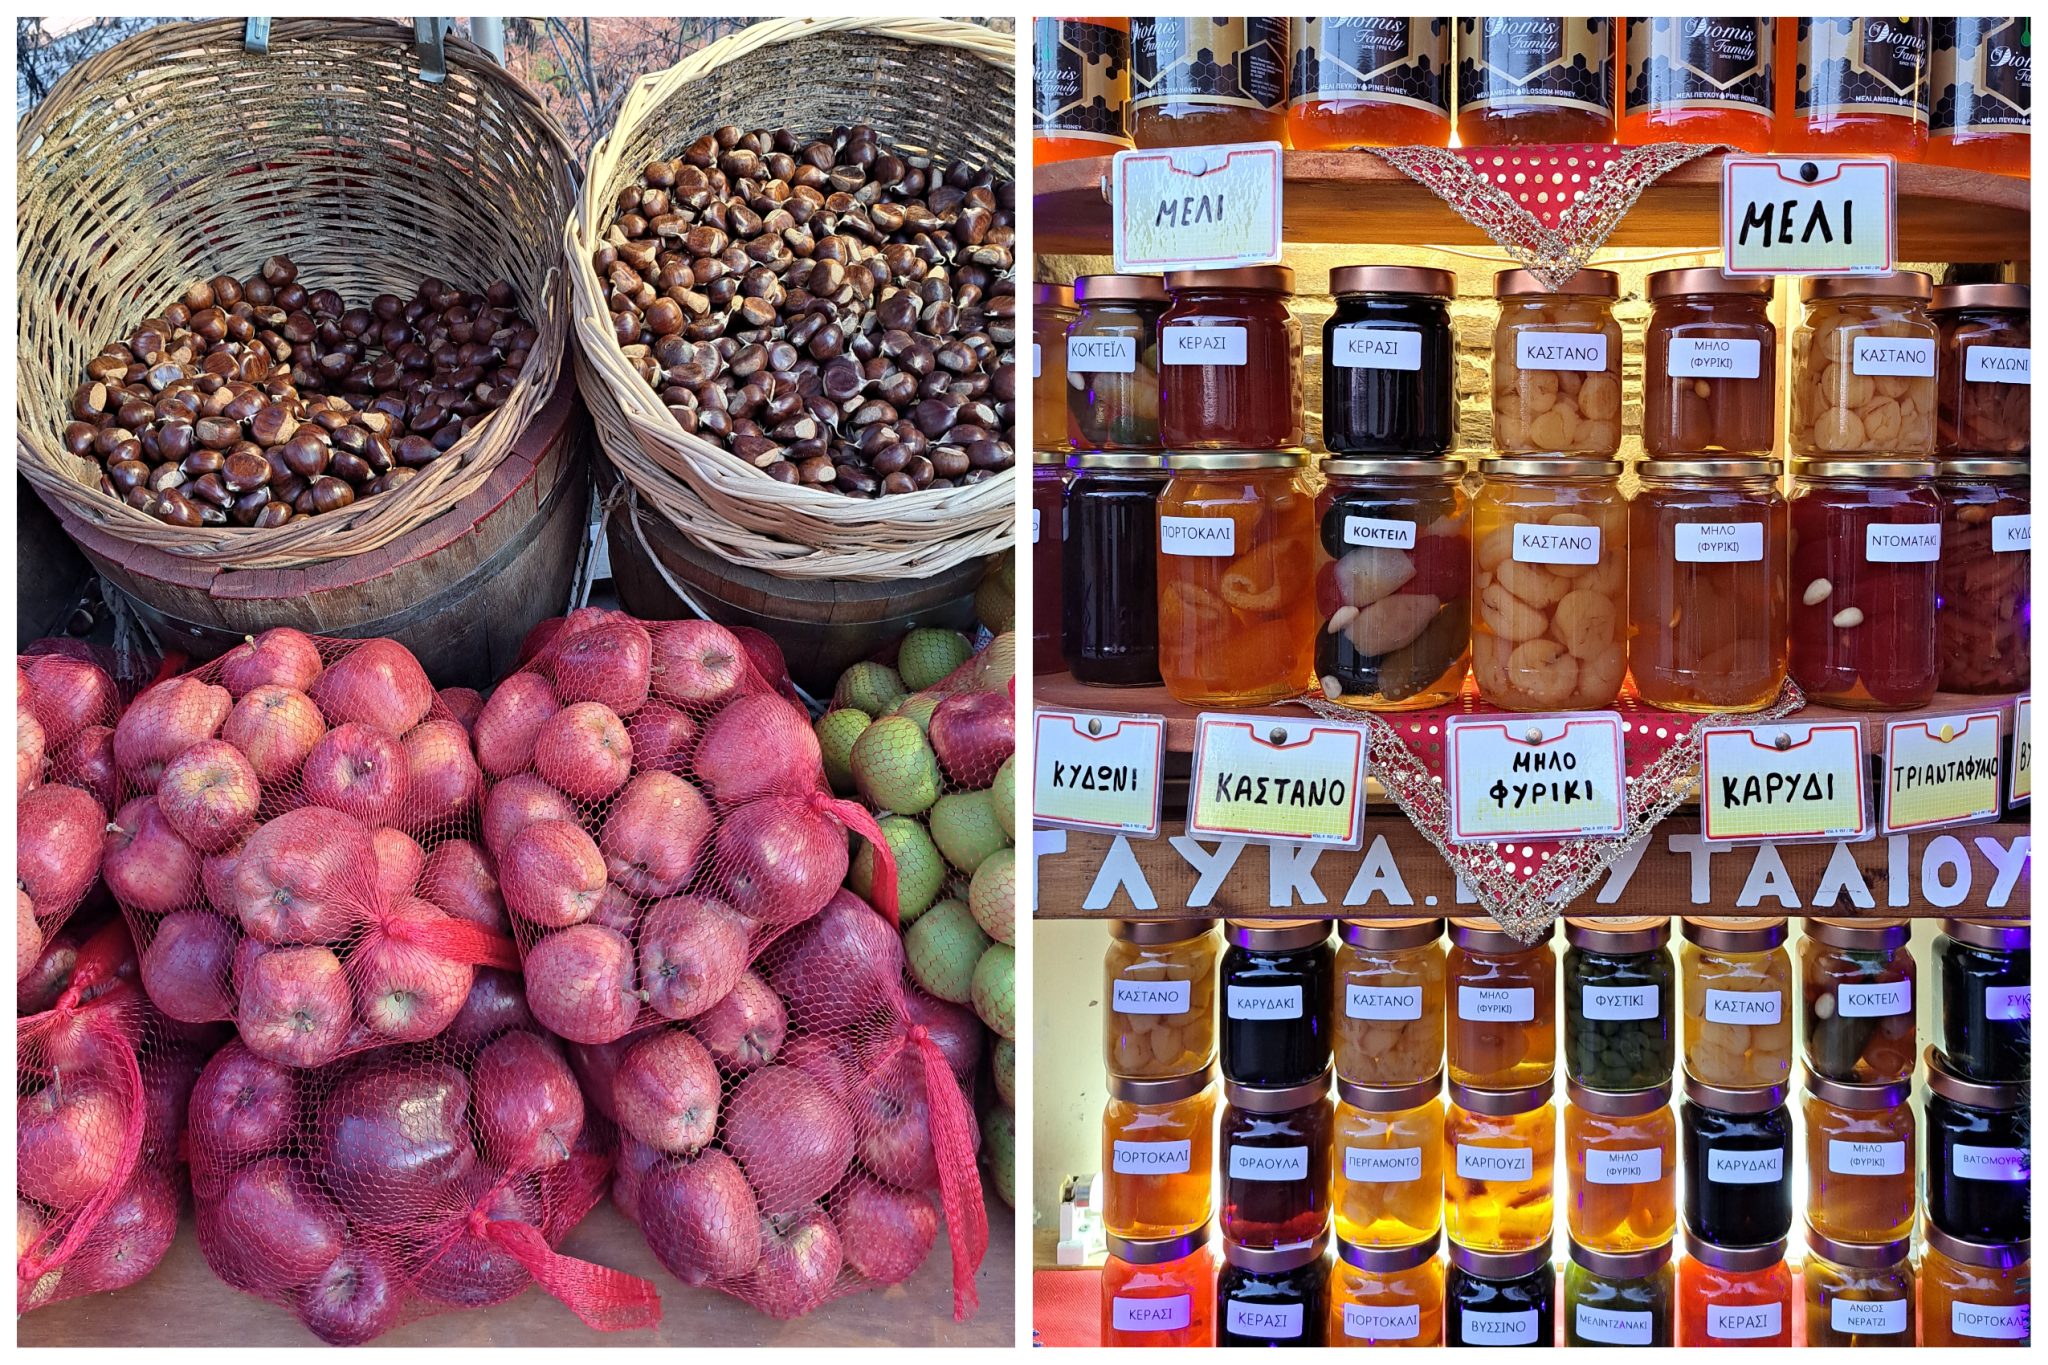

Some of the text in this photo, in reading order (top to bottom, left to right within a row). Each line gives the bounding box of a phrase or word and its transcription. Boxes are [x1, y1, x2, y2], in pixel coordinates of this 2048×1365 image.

[1484, 17, 1560, 38] Diomis
[1684, 17, 1757, 42] Diomis
[1353, 28, 1406, 51] Family
[1868, 20, 1927, 51] Diomis
[1142, 34, 1181, 54] Family
[1508, 34, 1560, 54] Family
[1711, 38, 1757, 61] Family
[1033, 66, 1080, 81] iomis
[1179, 86, 1202, 94] HONEY
[1367, 83, 1384, 92] PINE
[1385, 85, 1408, 95] HONEY
[1554, 89, 1576, 98] HONEY
[1725, 92, 1740, 100] PINE
[1740, 94, 1758, 103] HONEY
[1155, 194, 1224, 229] ΜΕΛΙ
[1738, 199, 1853, 248] ΜΕΛΙ
[1178, 335, 1226, 350] ΚΕΡΑΣΙ
[1348, 339, 1398, 355] ΚΕΡΑΣΙ
[1694, 340, 1730, 352] ΜΗΛΟ
[1527, 345, 1599, 362] ΚΑΣΤΑΝΟ
[1860, 348, 1926, 364] ΚΑΣΤΑΝΟ
[1690, 357, 1733, 369] (ΦΥΡΙΚΙ)
[1981, 356, 2028, 371] ΚΥΔΩΝΙ
[1162, 524, 1231, 541] ΠΟΡΤΟΚΑΛΙ
[1353, 525, 1408, 541] ΚΟΚΤΕΙΛ
[1701, 525, 1736, 536] ΜΗΛΟ
[1522, 534, 1592, 550] ΚΑΣΤΑΝΟ
[1697, 541, 1740, 553] (ΦΥΡΙΚΙ)
[1872, 535, 1937, 548] ΝΤΟΜΑΤΑΚΙ
[1512, 750, 1576, 773] ΜΗΛΟ
[1052, 760, 1138, 792] ΚΥΔΩΝΙ
[1215, 771, 1346, 808] ΚΑΣΤΑΝΟ
[1489, 779, 1593, 809] ΦΥΡΙΚΙ
[1722, 772, 1834, 809] ΚΑΡΥΔΙ
[1118, 989, 1179, 1003] ΚΑΣΤΑΝΟ
[1353, 994, 1414, 1007] ΚΑΣΤΑΝΟ
[1479, 990, 1509, 1000] ΜΗΛΟ
[1595, 994, 1643, 1007] ΦΥΣΤΙΚΙ
[1848, 992, 1900, 1006] ΚΟΚΤΕΙΛ
[1237, 998, 1294, 1010] ΚΑΡΥΔΑΚΙ
[1476, 1003, 1512, 1015] (ΦΥΡΙΚΙ)
[1714, 1000, 1775, 1013] ΚΑΣΤΑΝΟ
[1852, 1143, 1883, 1153] ΜΗΛΟ
[1114, 1149, 1189, 1164] ΠΟΡΤΟΚΑΛΙ
[1239, 1156, 1300, 1169] ΦΡΑΟΥΛΑ
[1349, 1156, 1419, 1169] ΠΕΡΓΑΜΟΝΤΟ
[1464, 1156, 1525, 1170] ΚΑΡΠΟΥΖΙ
[1609, 1152, 1639, 1162] ΜΗΛΟ
[1850, 1157, 1885, 1168] (ΦΥΡΙΚΙ)
[1606, 1166, 1641, 1177] (ΦΥΡΙΚΙ)
[1717, 1158, 1777, 1172] ΚΑΡΥΔΑΚΙ
[1129, 1307, 1172, 1322] ΚΕΡΑΣΙ
[1850, 1303, 1884, 1313] ΑΝΘΟΣ
[1238, 1311, 1287, 1328] ΚΕΡΑΣΙ
[1347, 1312, 1417, 1327] ΠΟΡΤΟΚΑΛΙ
[1579, 1314, 1648, 1330] ΜΕΛΙΝΤΖΑΝΑΚΙ
[1719, 1315, 1767, 1329] ΚΕΡΑΣΙ
[1848, 1316, 1886, 1327] ΝΕΡΑΤΖΙ
[1471, 1320, 1526, 1334] ΒΥΣΣΙΝΟ
